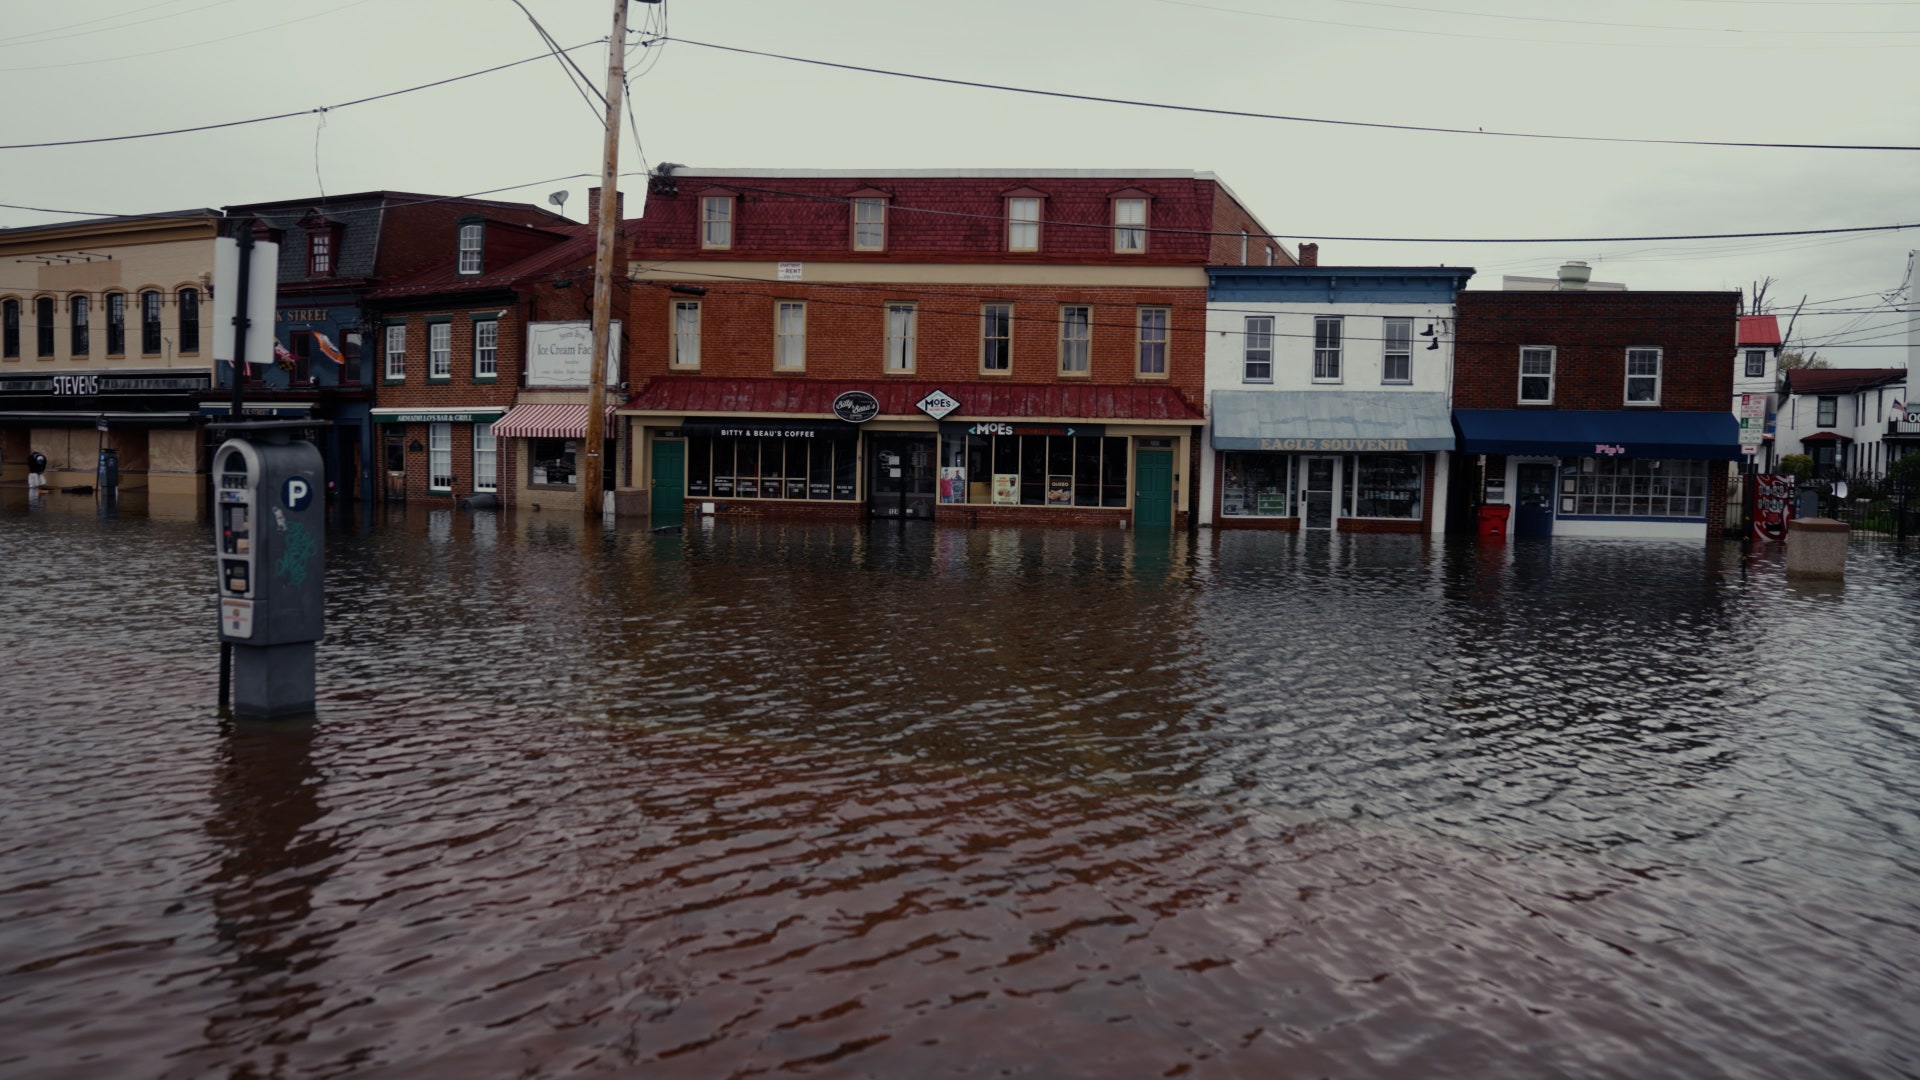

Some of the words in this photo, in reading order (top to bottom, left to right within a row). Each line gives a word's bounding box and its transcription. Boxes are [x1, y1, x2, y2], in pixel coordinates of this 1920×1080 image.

[287, 309, 329, 321] STREET
[537, 344, 549, 355] Ice
[550, 343, 576, 355] Cream
[577, 343, 593, 355] Fac
[53, 375, 98, 395] STEVENS
[455, 414, 473, 422] GRILL
[784, 430, 815, 438] COFFEE
[1260, 439, 1317, 450] EAGLE
[1319, 439, 1409, 450] SOUVENIR
[1595, 444, 1625, 456] Pip's
[289, 480, 308, 507] P
